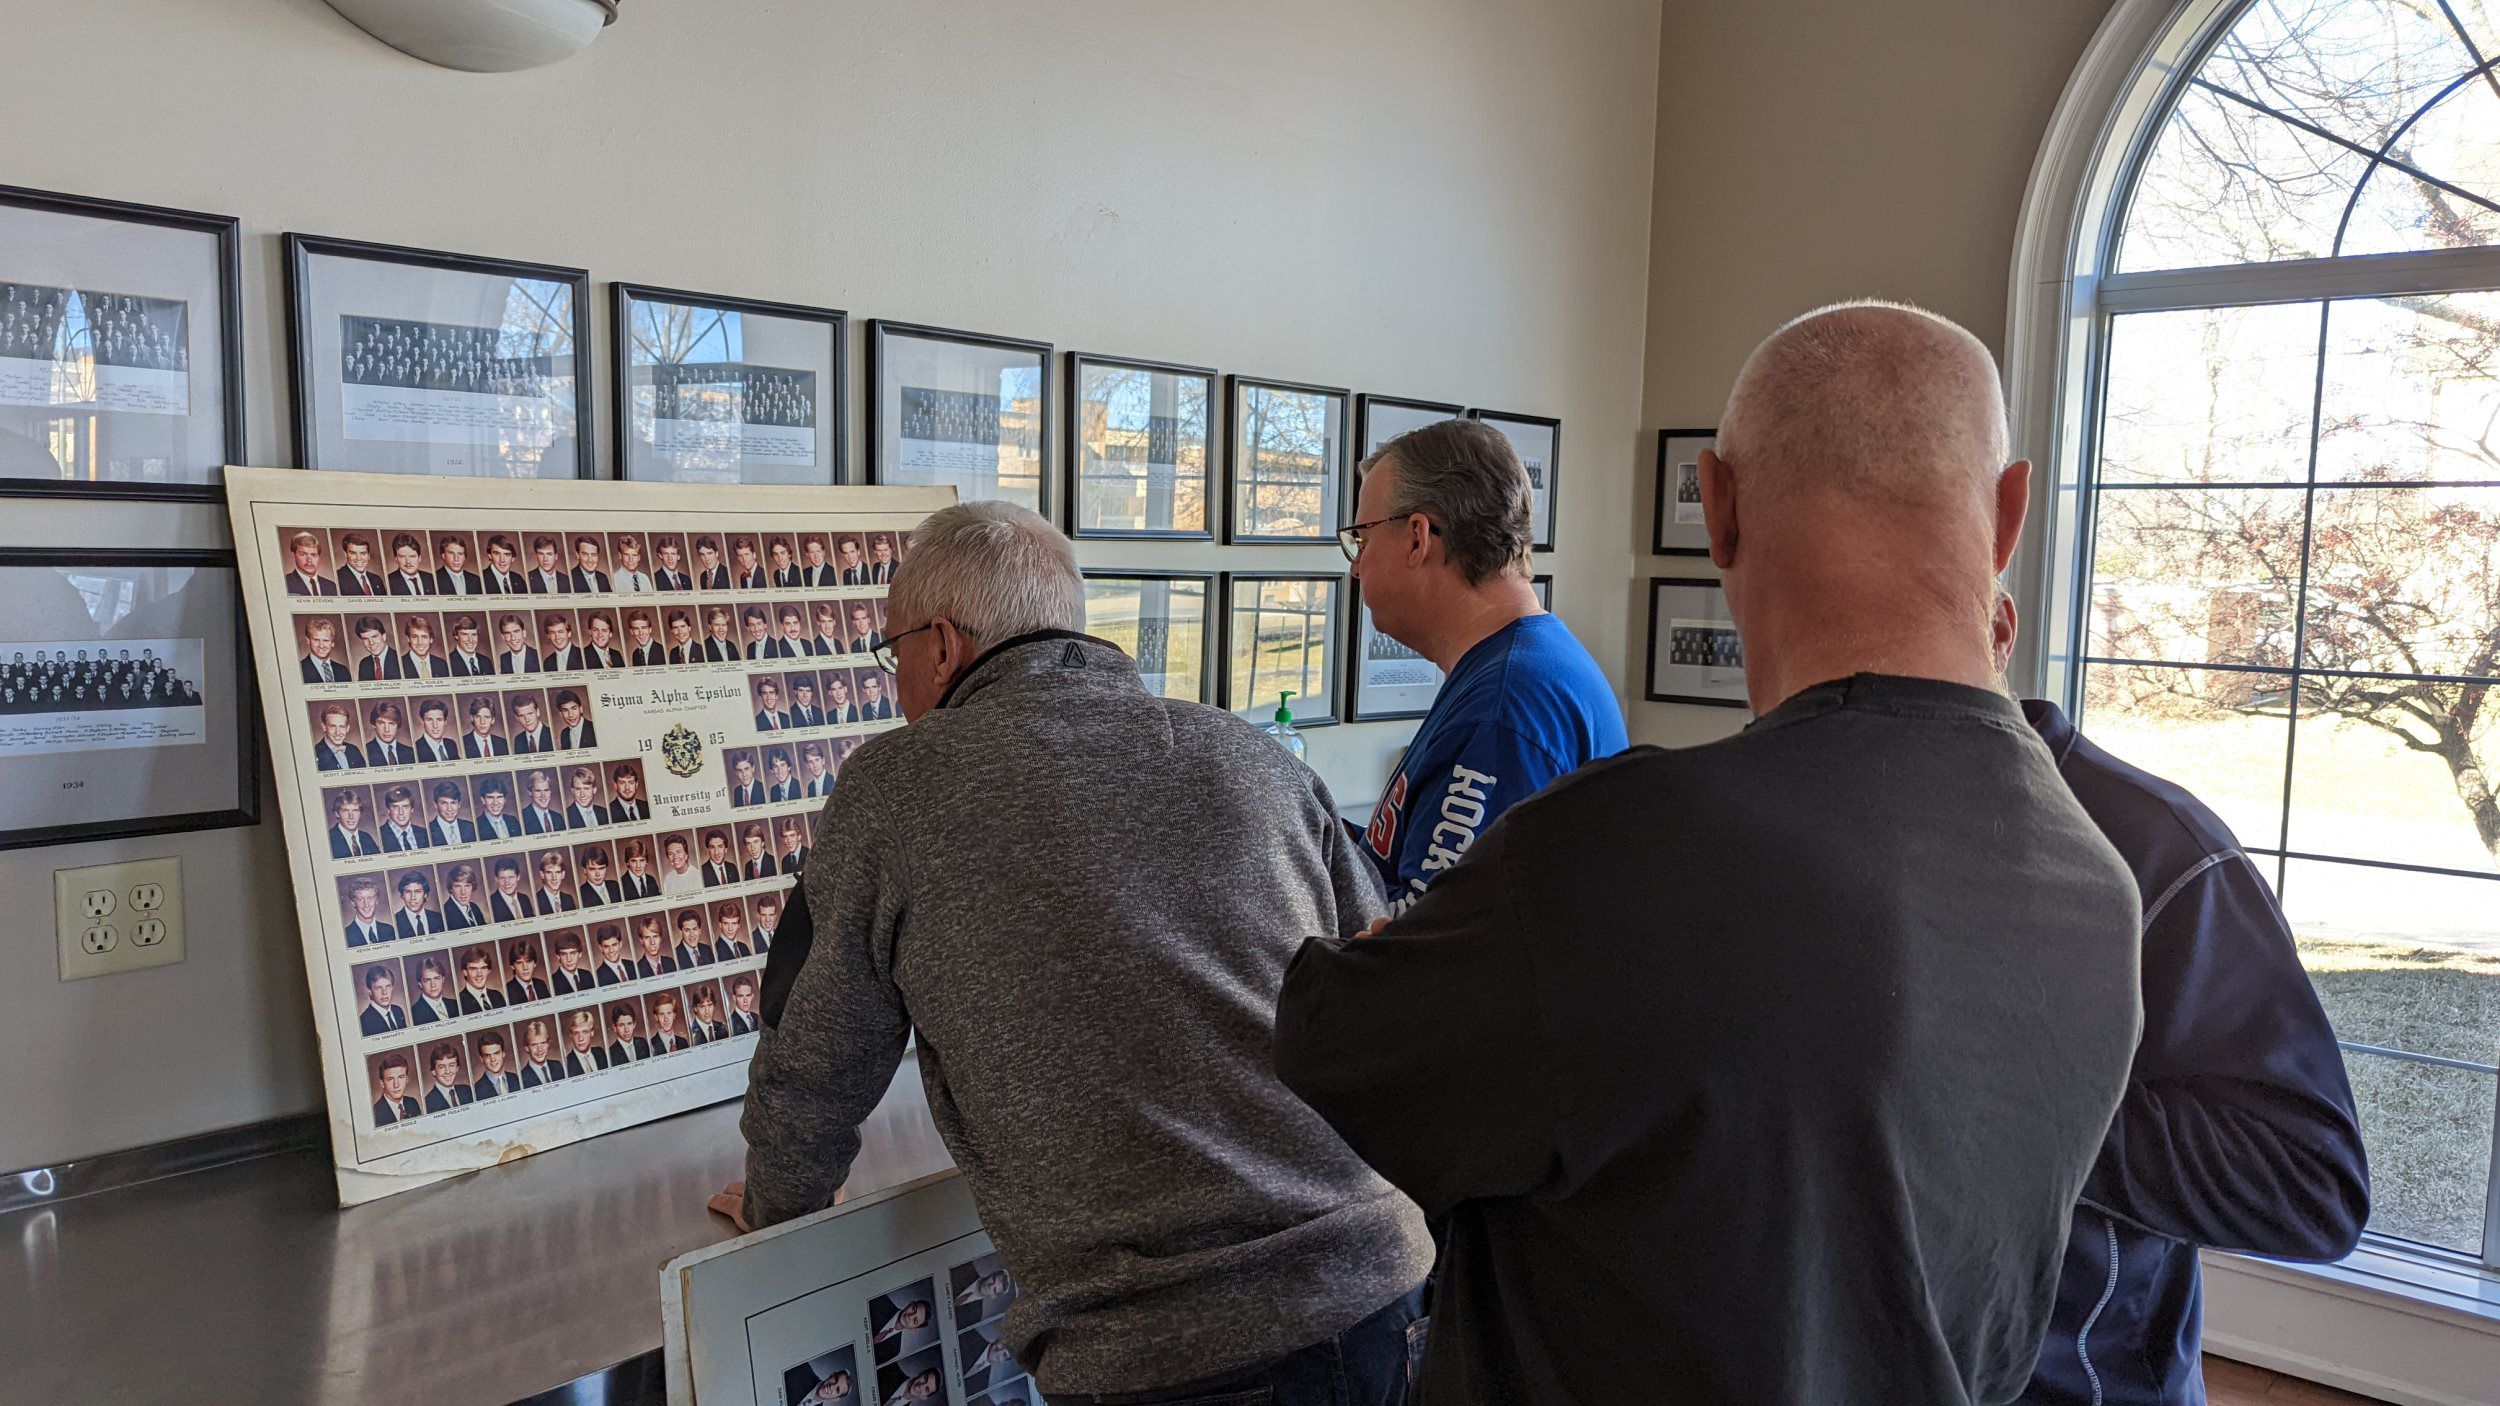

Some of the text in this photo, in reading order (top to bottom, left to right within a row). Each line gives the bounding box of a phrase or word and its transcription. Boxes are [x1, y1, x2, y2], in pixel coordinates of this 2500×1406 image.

[600, 685, 742, 709] Sigma Alpha Epsilon
[638, 731, 725, 752] 19 85
[63, 781, 84, 789] 1934
[652, 787, 727, 806] University of
[670, 804, 712, 817] Kansas
